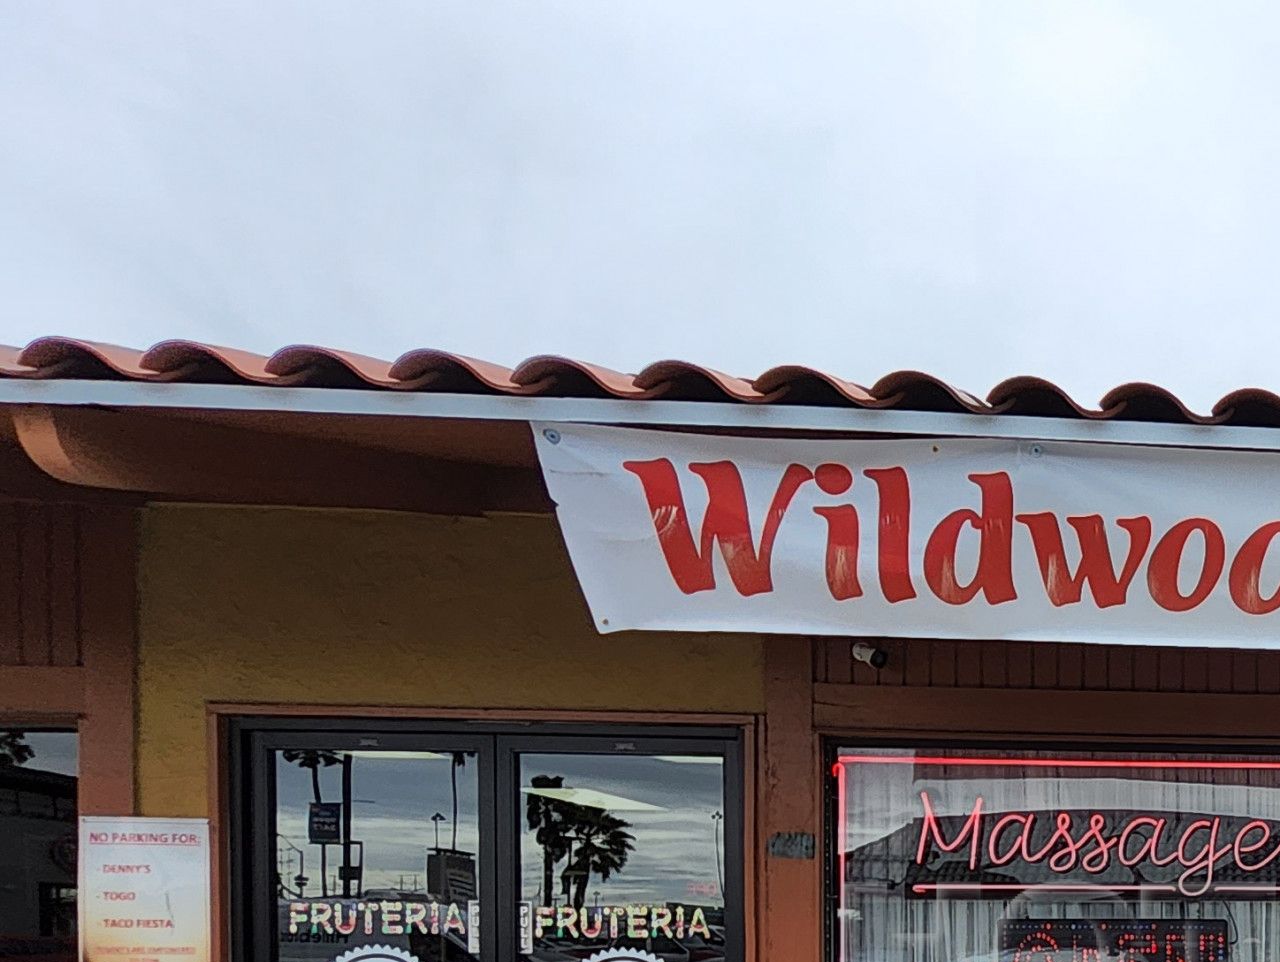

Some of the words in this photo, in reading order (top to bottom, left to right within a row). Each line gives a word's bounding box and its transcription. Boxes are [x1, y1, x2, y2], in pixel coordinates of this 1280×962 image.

[89, 832, 109, 843] NO
[112, 832, 168, 843] PARKING
[102, 864, 151, 874] DENNY'S
[102, 891, 136, 901] TOGO
[289, 900, 466, 935] FRUTERIA
[534, 904, 712, 939] FRUTERIA
[103, 918, 134, 928] TACO
[136, 918, 174, 928] FIESTA
